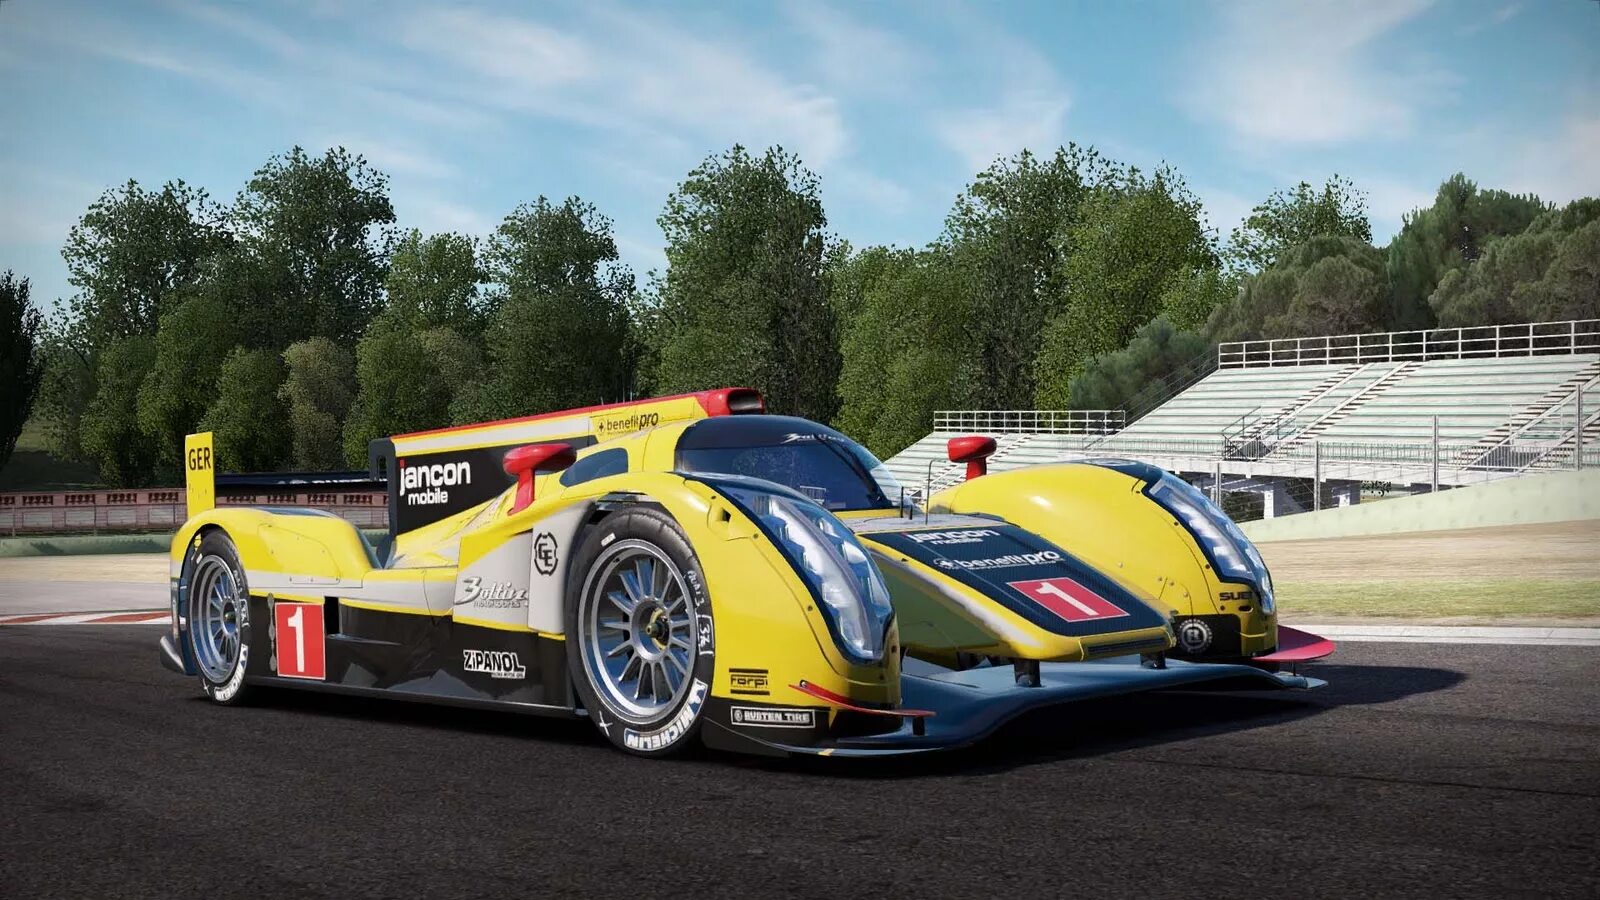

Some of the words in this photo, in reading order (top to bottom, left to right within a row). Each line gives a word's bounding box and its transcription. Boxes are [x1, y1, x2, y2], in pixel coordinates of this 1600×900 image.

[188, 446, 212, 471] GER
[399, 459, 471, 496] jancon
[408, 488, 448, 505] mobile
[901, 529, 1000, 543] jancon
[1035, 581, 1099, 616] 1
[287, 606, 305, 673] 1
[626, 703, 695, 749] MICHELIN
